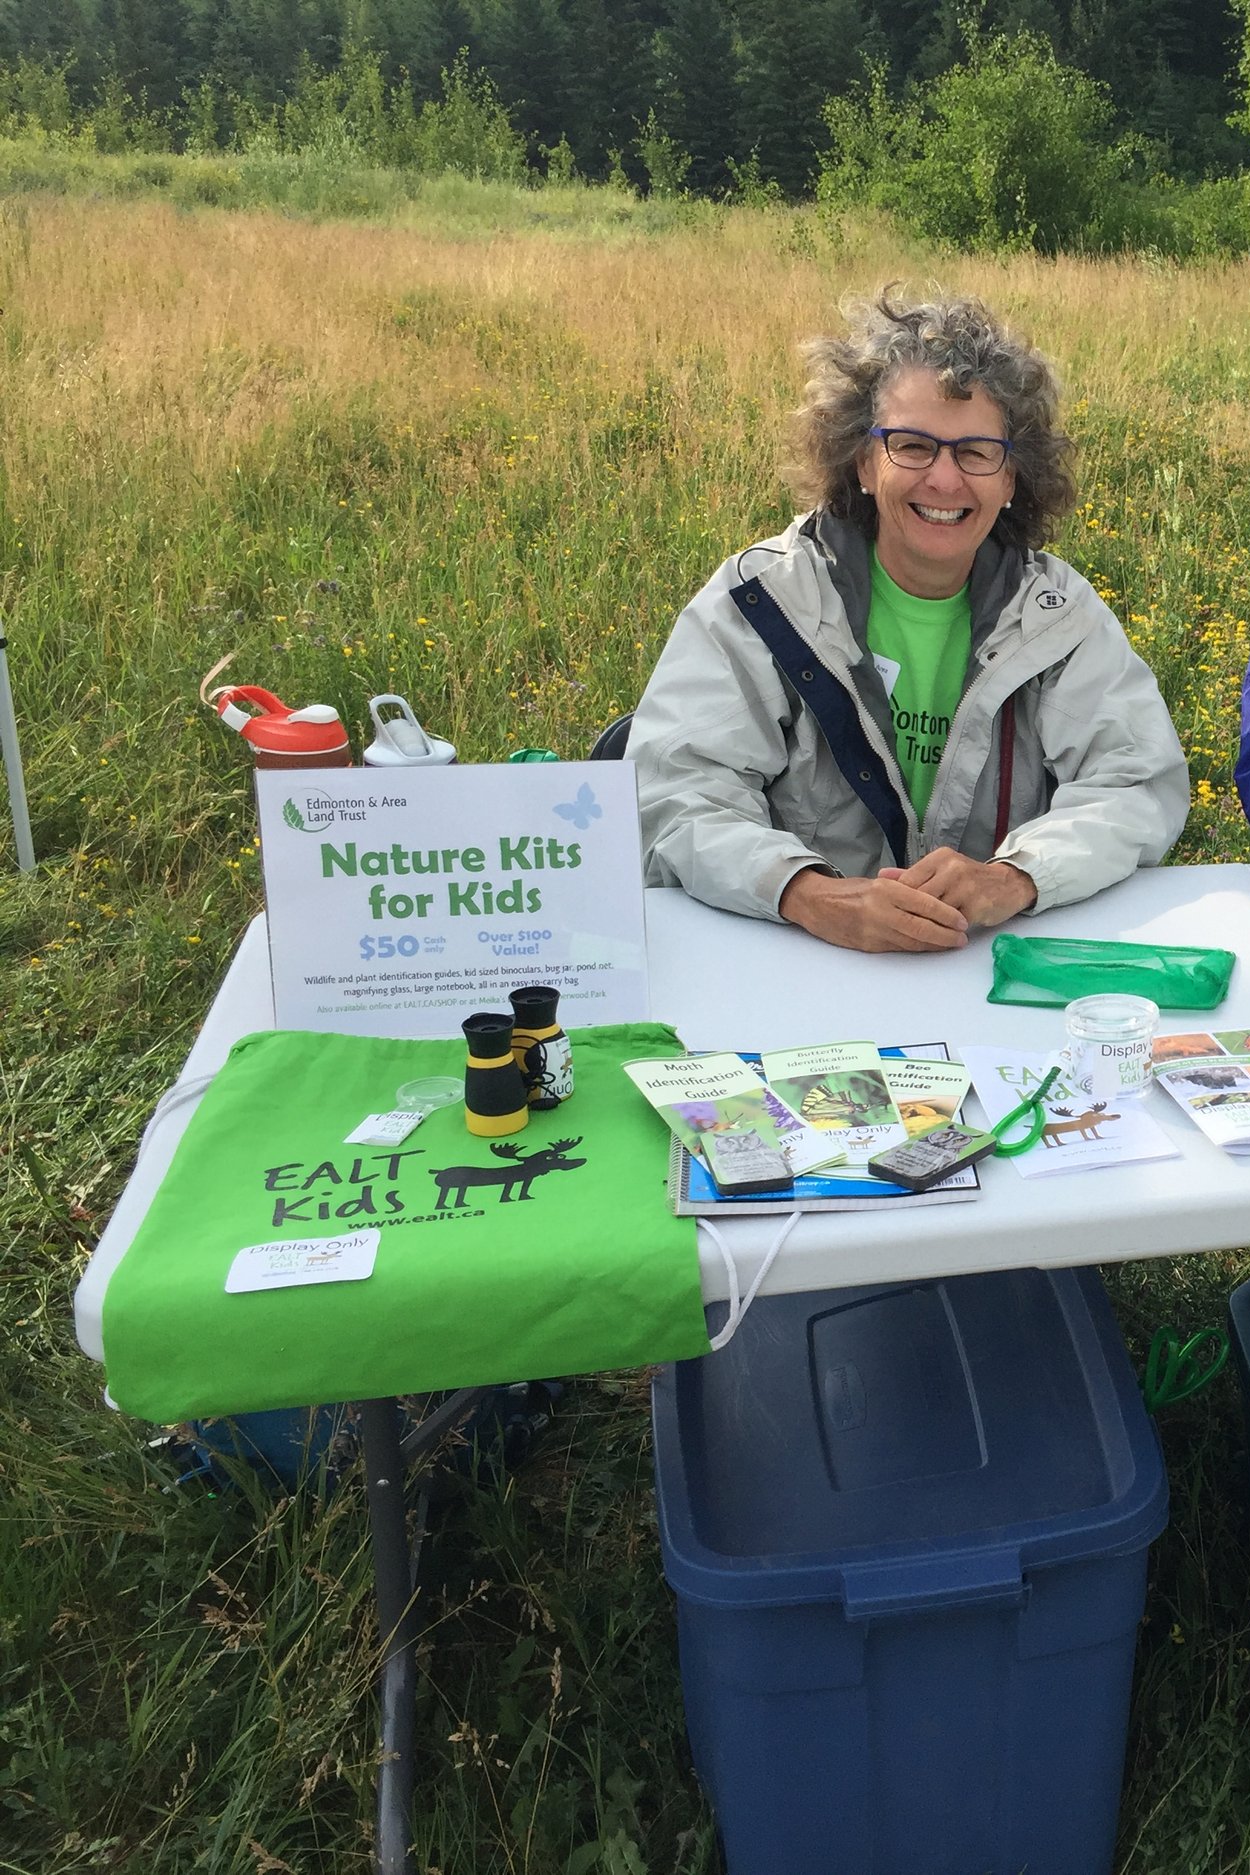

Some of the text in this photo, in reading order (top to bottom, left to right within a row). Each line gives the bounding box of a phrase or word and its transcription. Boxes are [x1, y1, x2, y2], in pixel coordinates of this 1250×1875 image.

[890, 709, 949, 735] onton
[906, 735, 942, 764] Trus
[306, 796, 407, 810] Edmonton & Area
[308, 810, 366, 822] Land Trust
[321, 836, 583, 878] Nature Kits
[368, 879, 542, 920] for Kids
[424, 936, 446, 944] Cash
[478, 930, 552, 943] Over $100
[359, 934, 420, 961] $50
[424, 945, 444, 954] only
[492, 943, 540, 956] Value!
[304, 975, 336, 985] Wildlife
[338, 975, 353, 983] and
[356, 974, 376, 984] plant
[379, 971, 432, 981] identification
[464, 968, 476, 977] kid
[479, 967, 498, 976] sized
[501, 964, 543, 975] binoculars,
[545, 964, 560, 974] bug
[577, 963, 596, 972] pond
[344, 988, 388, 998] magnifying
[390, 986, 412, 995] glass,
[414, 985, 434, 994] large
[479, 981, 487, 989] all
[564, 976, 579, 986] bag
[369, 1002, 392, 1010] online
[591, 990, 606, 998] Park
[797, 1047, 844, 1058] Butterfly
[1101, 1042, 1148, 1058] Display
[664, 1062, 703, 1072] Moth
[787, 1054, 859, 1068] Identification
[809, 1064, 841, 1074] Guide
[646, 1069, 743, 1088] Identification
[887, 1072, 963, 1083] ntification
[889, 1081, 932, 1090] Guide
[685, 1088, 728, 1099] Guide
[856, 1124, 892, 1135] Only
[778, 1132, 804, 1147] nly
[264, 1149, 426, 1192] EALT
[271, 1185, 406, 1227] Kids
[347, 1208, 486, 1230] www.ealt.ca
[250, 1238, 368, 1254] Display Only
